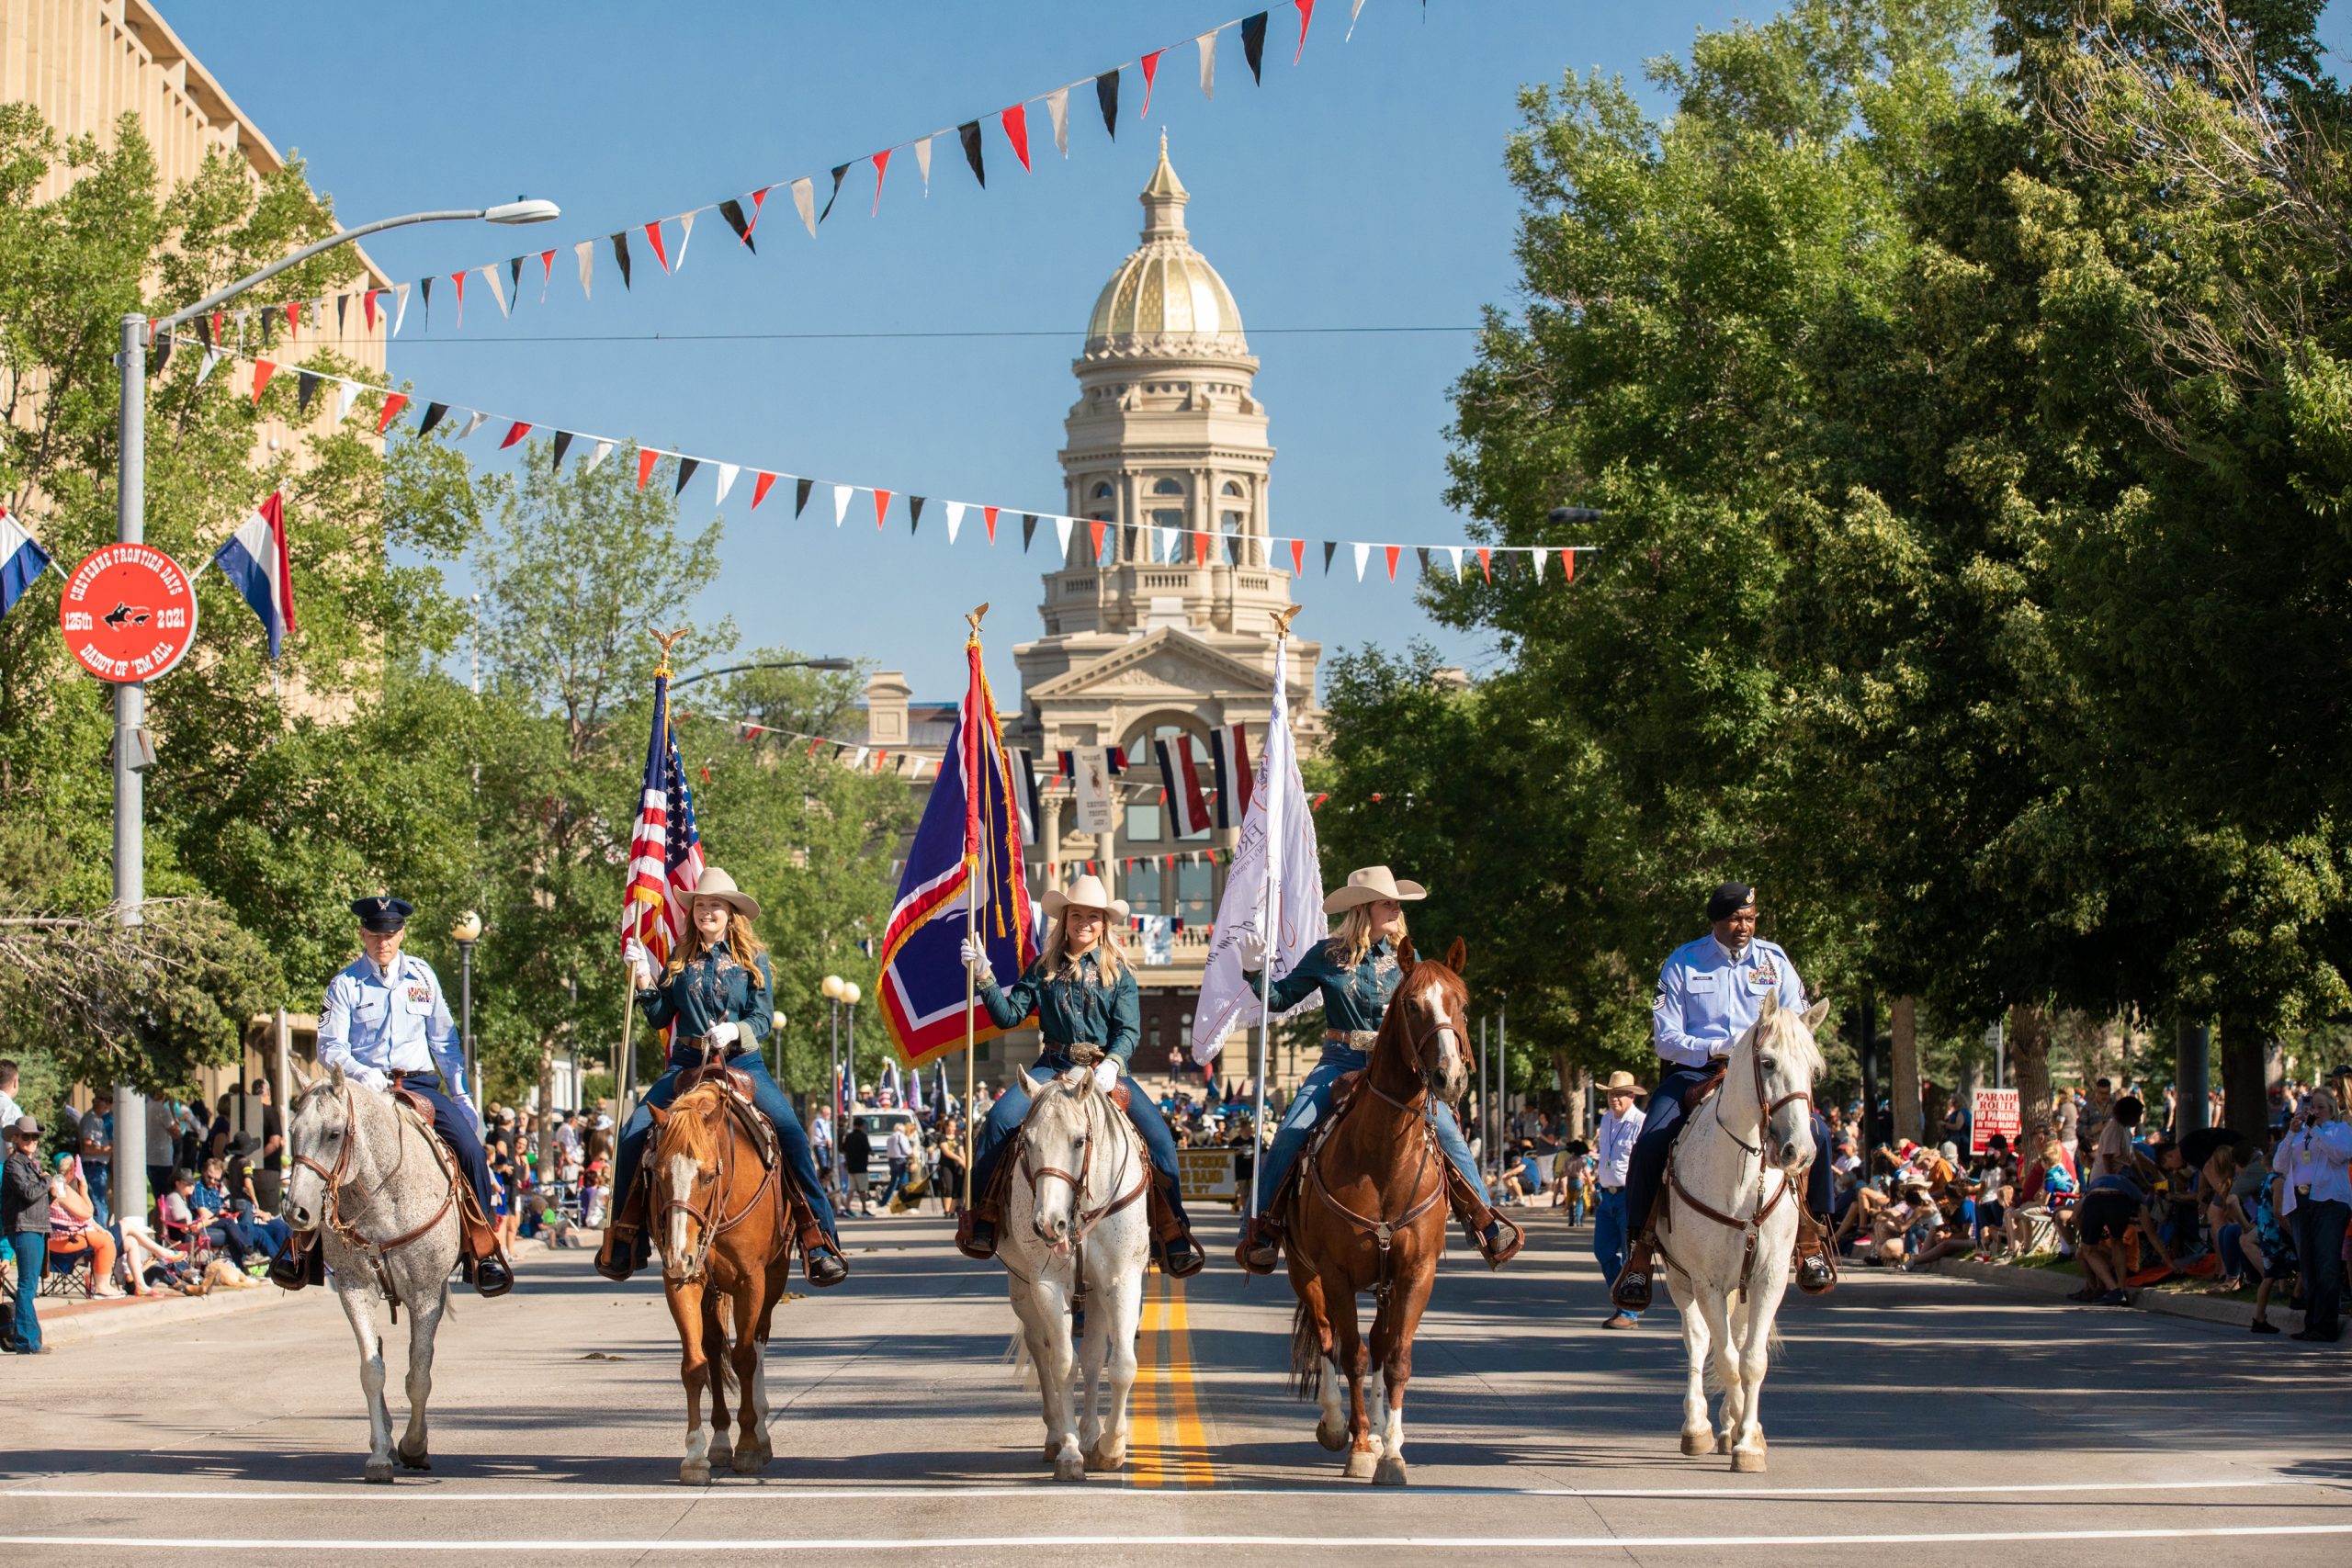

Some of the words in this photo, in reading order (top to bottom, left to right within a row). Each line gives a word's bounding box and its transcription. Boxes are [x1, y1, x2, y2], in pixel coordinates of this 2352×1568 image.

[70, 552, 112, 602] CHEYENNE
[113, 548, 164, 572] FRONTIER
[160, 567, 184, 595] DAYS
[65, 612, 93, 631] 125th
[157, 608, 186, 629] 2021
[80, 643, 115, 674] DADDY
[115, 660, 129, 677] OF
[131, 655, 153, 675] 'EM
[151, 641, 175, 665] ALL
[1976, 1092, 2019, 1101] PARADE
[1979, 1101, 2016, 1110] ROUTE
[1975, 1111, 1985, 1121] NO
[1987, 1111, 2019, 1122] PARKING
[1193, 1169, 1224, 1183] BAND
